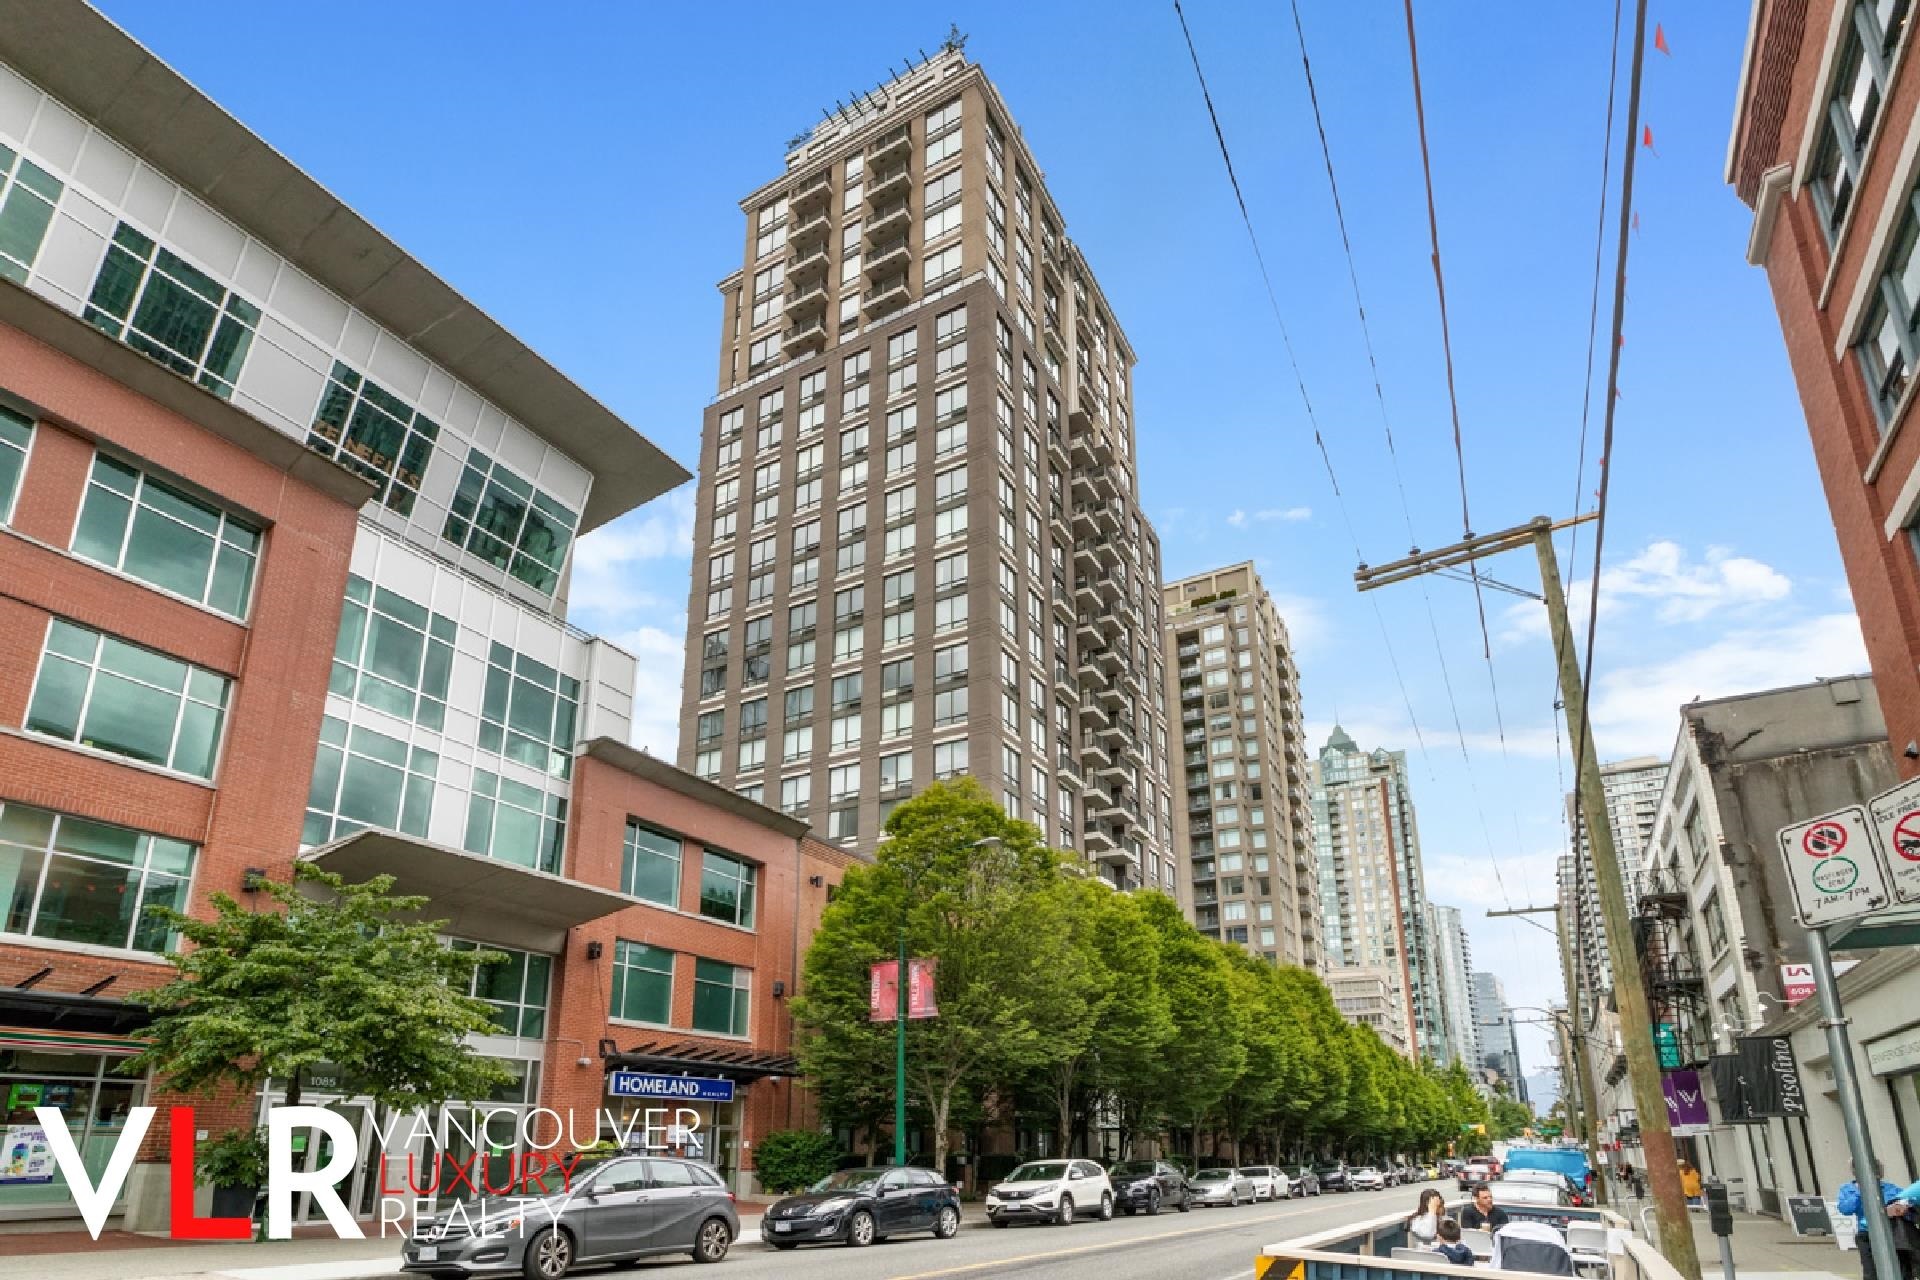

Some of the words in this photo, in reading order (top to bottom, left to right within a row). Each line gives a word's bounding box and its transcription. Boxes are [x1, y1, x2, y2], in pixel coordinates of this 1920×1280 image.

[311, 1076, 336, 1088] 1085
[1772, 1038, 1805, 1112] Pisolino
[619, 1076, 699, 1096] HOMELAND
